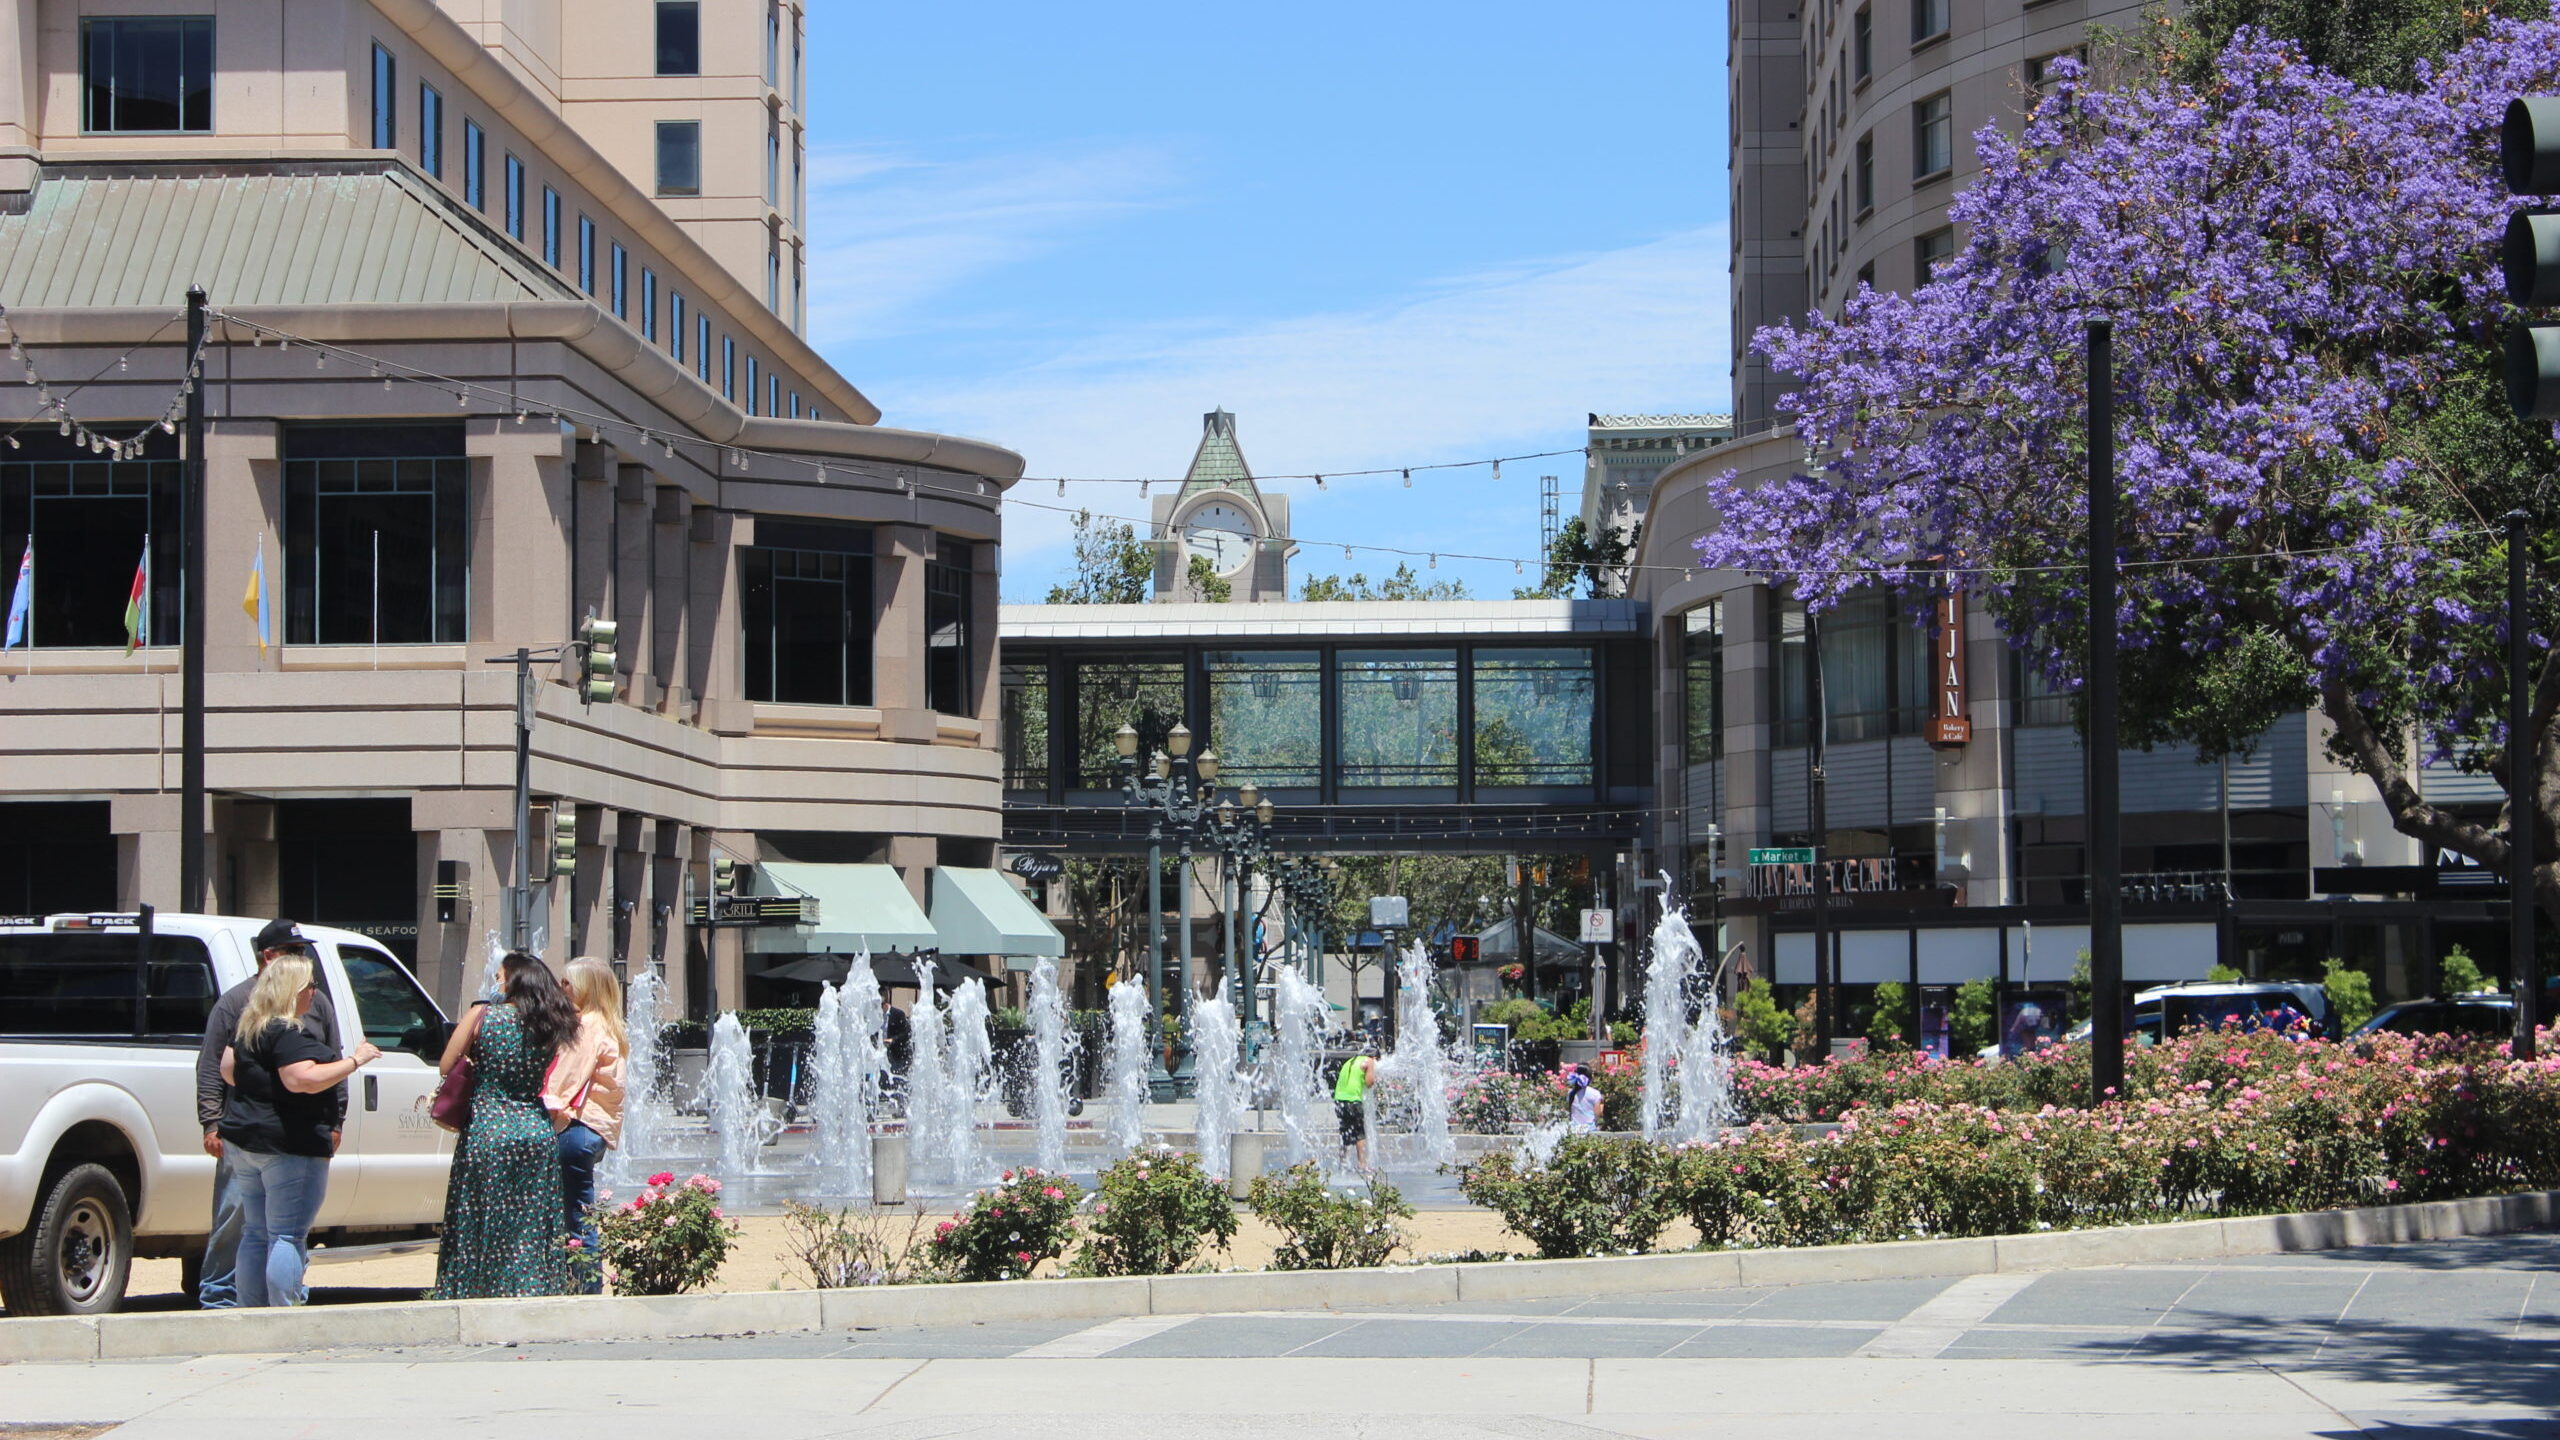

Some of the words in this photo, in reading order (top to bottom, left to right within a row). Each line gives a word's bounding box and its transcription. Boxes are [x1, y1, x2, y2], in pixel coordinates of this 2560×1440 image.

[1943, 723, 1965, 732] Bakery
[1761, 851, 1799, 862] Market
[1017, 852, 1059, 878] Bijan
[91, 917, 137, 925] RACK
[398, 1112, 417, 1129] SAN
